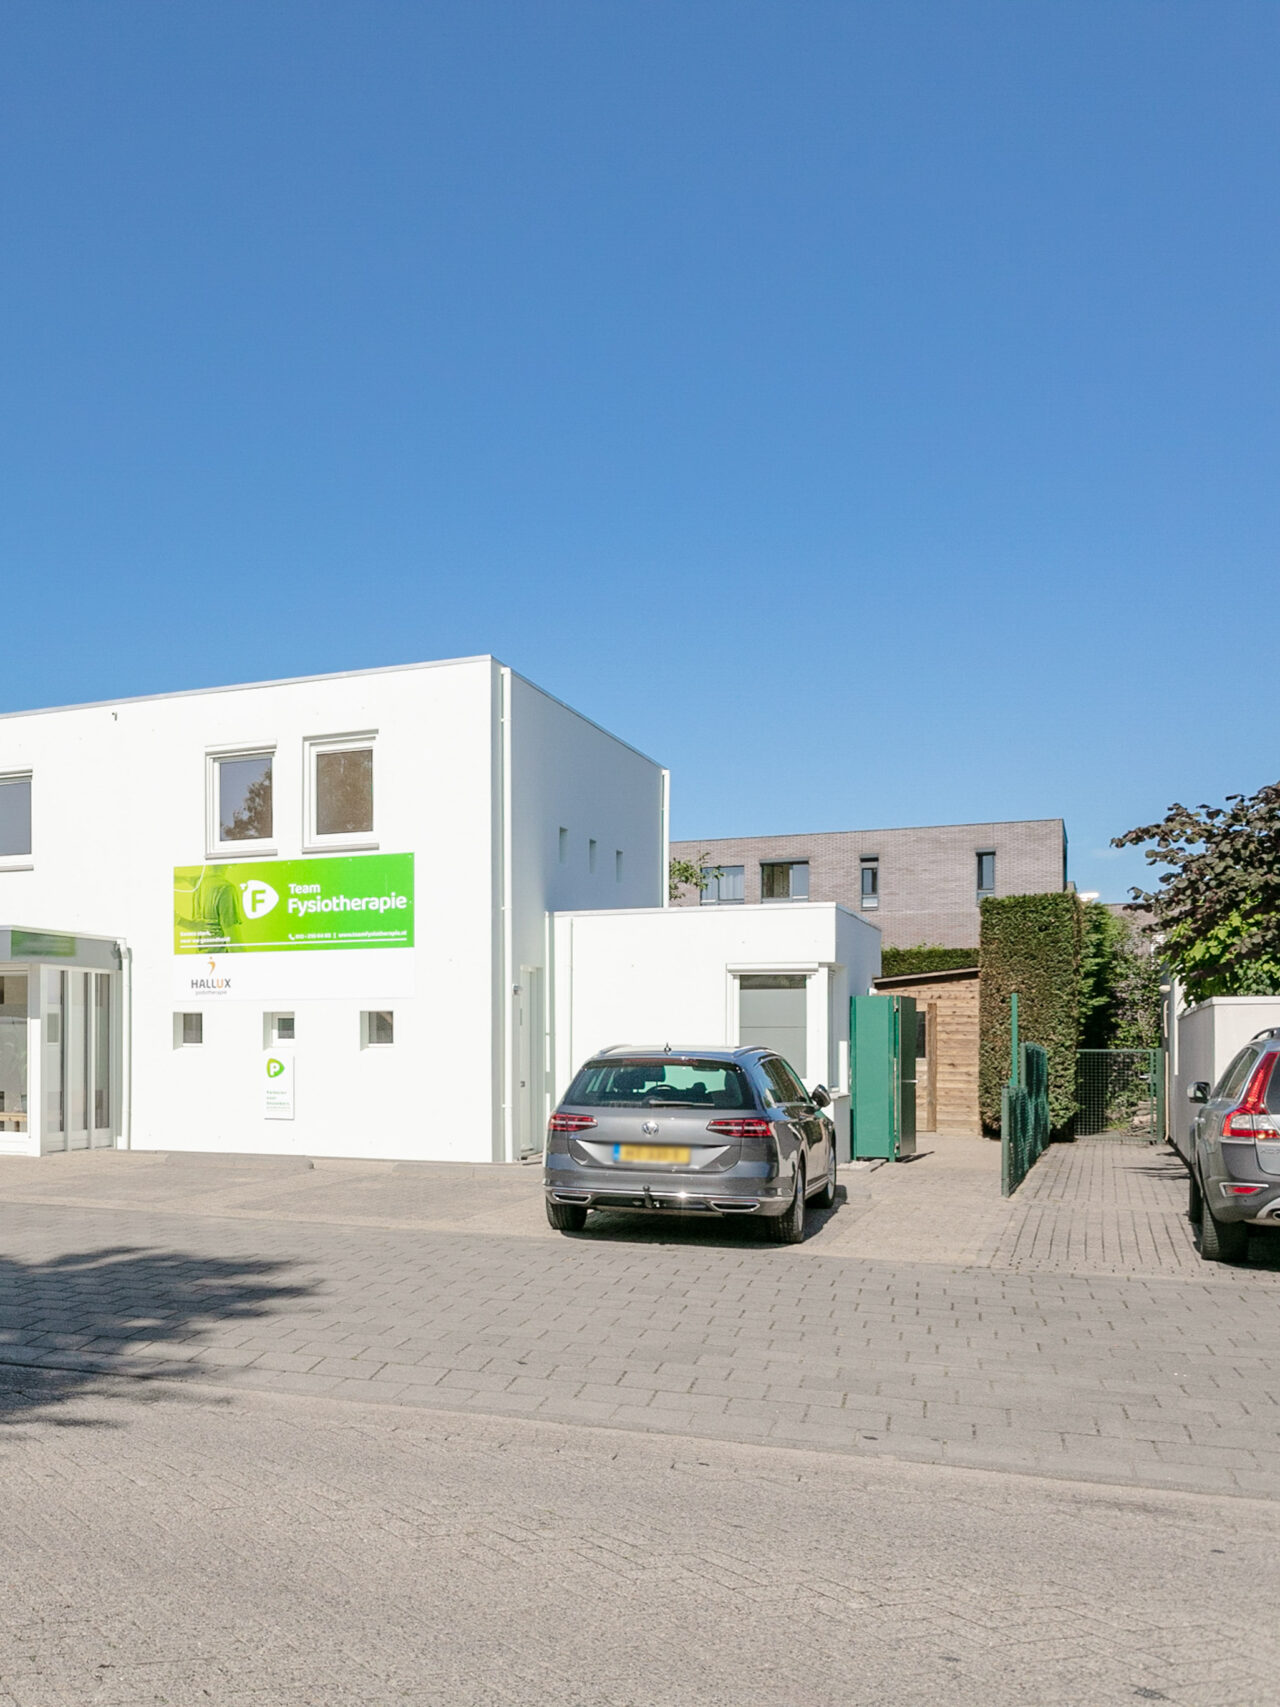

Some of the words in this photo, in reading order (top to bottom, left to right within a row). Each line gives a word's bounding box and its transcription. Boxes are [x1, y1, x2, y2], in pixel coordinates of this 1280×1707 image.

[288, 883, 321, 895] Team
[287, 891, 407, 917] Fysiotherapie
[191, 977, 232, 989] HALLUX
